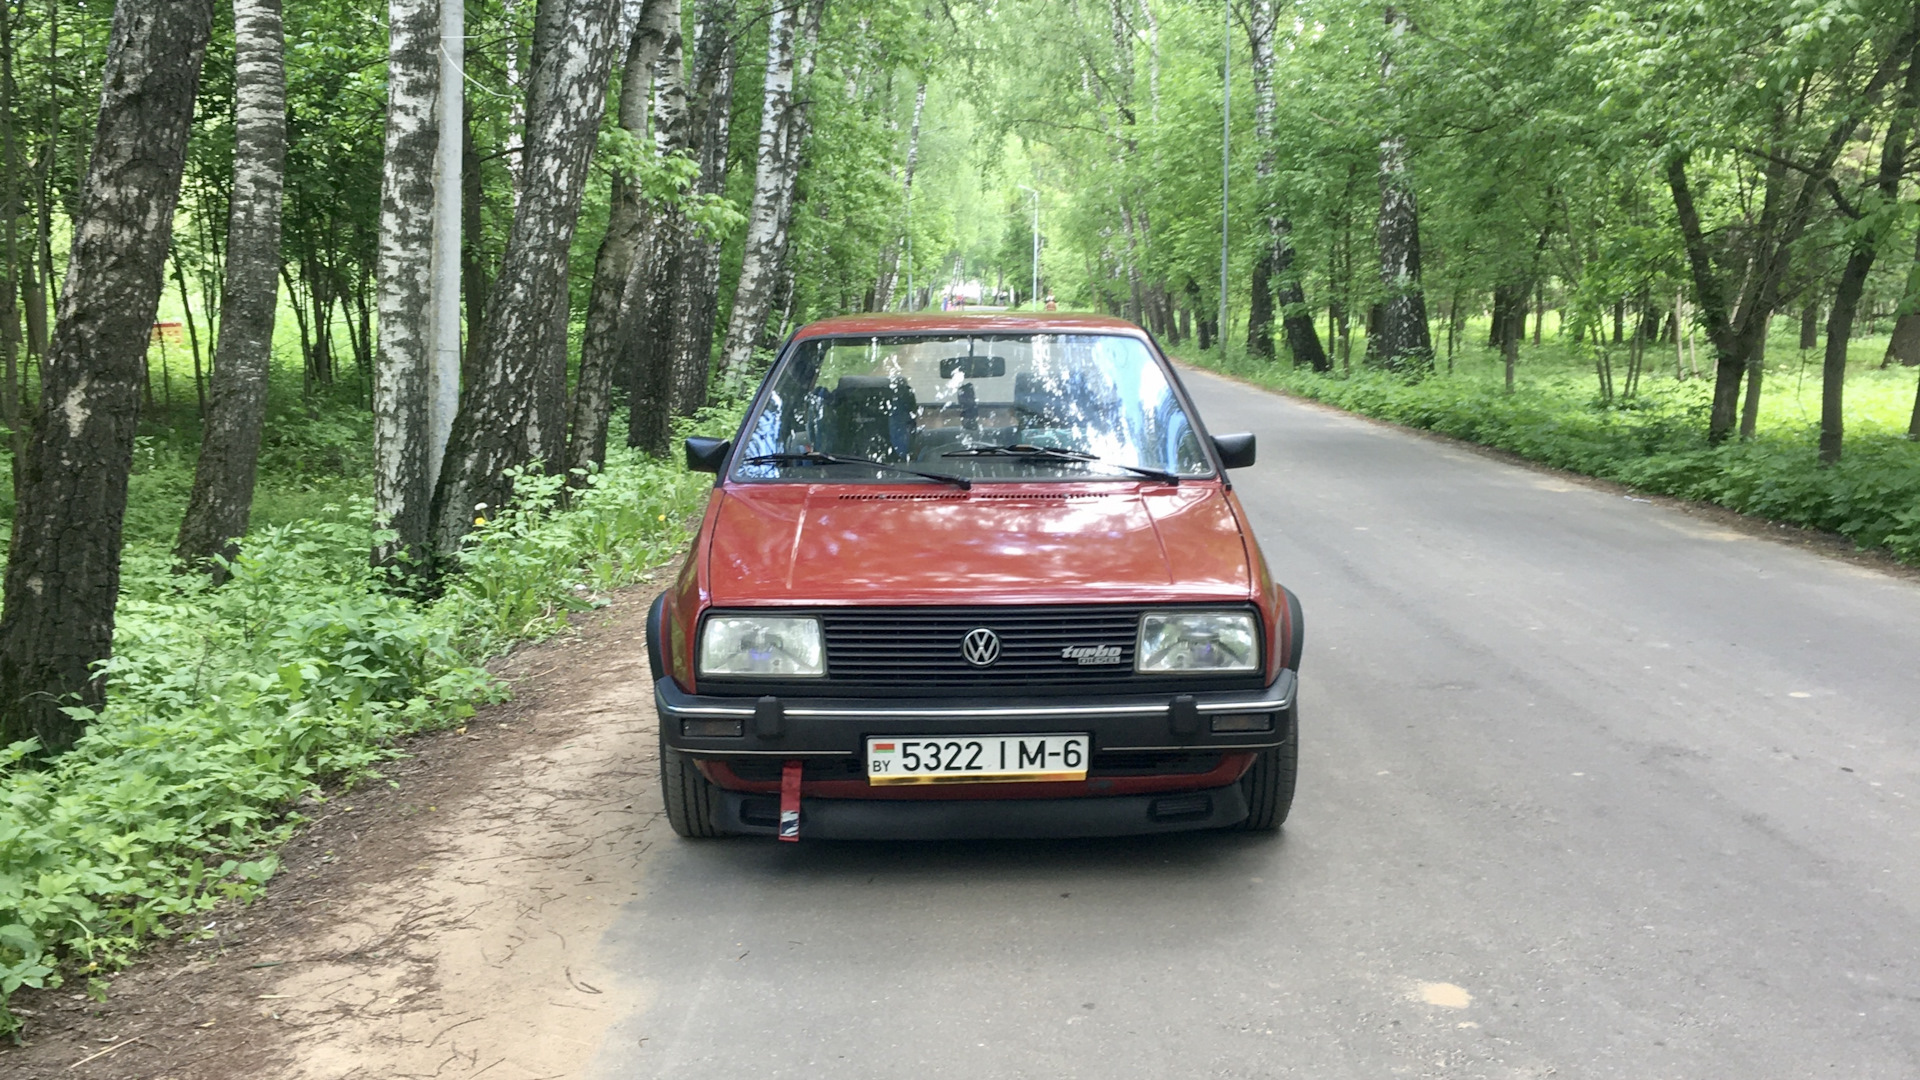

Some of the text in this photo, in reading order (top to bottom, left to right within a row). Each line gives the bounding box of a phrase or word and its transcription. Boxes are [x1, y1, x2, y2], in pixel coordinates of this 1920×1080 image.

[1062, 645, 1122, 658] turbo
[902, 740, 1082, 772] 5322 IM-6
[873, 760, 891, 772] BY
